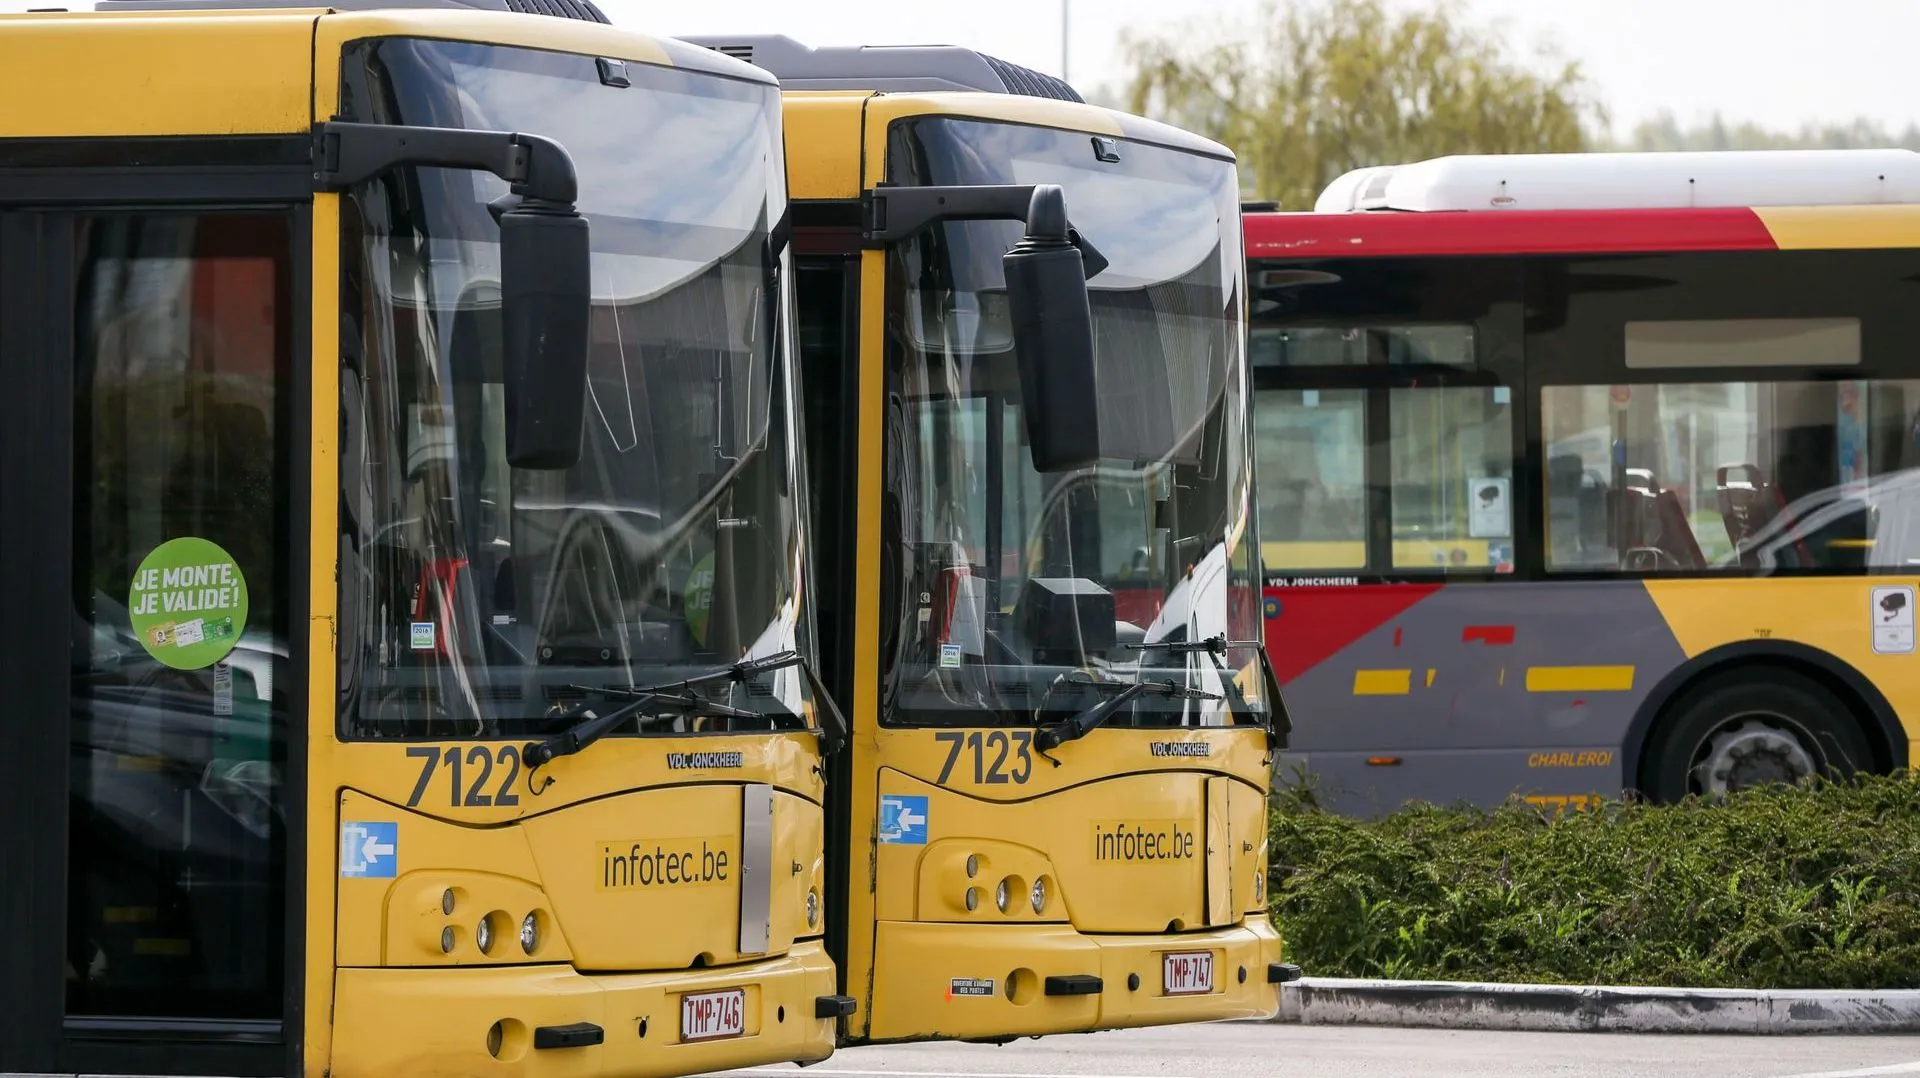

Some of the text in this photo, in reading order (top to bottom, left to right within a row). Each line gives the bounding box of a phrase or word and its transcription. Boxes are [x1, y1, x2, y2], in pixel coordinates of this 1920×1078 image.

[134, 563, 238, 591] JE MONTE,
[1269, 577, 1359, 587] VDL JONCKHEERE
[133, 592, 158, 615] JE
[667, 753, 688, 770] VDL
[934, 731, 1033, 785] 7123
[1150, 742, 1168, 757] VDL
[1528, 751, 1613, 768] CHARLEROI
[405, 746, 520, 807] 7122
[1095, 822, 1194, 861] infotec.be
[603, 841, 729, 888] infotec.be
